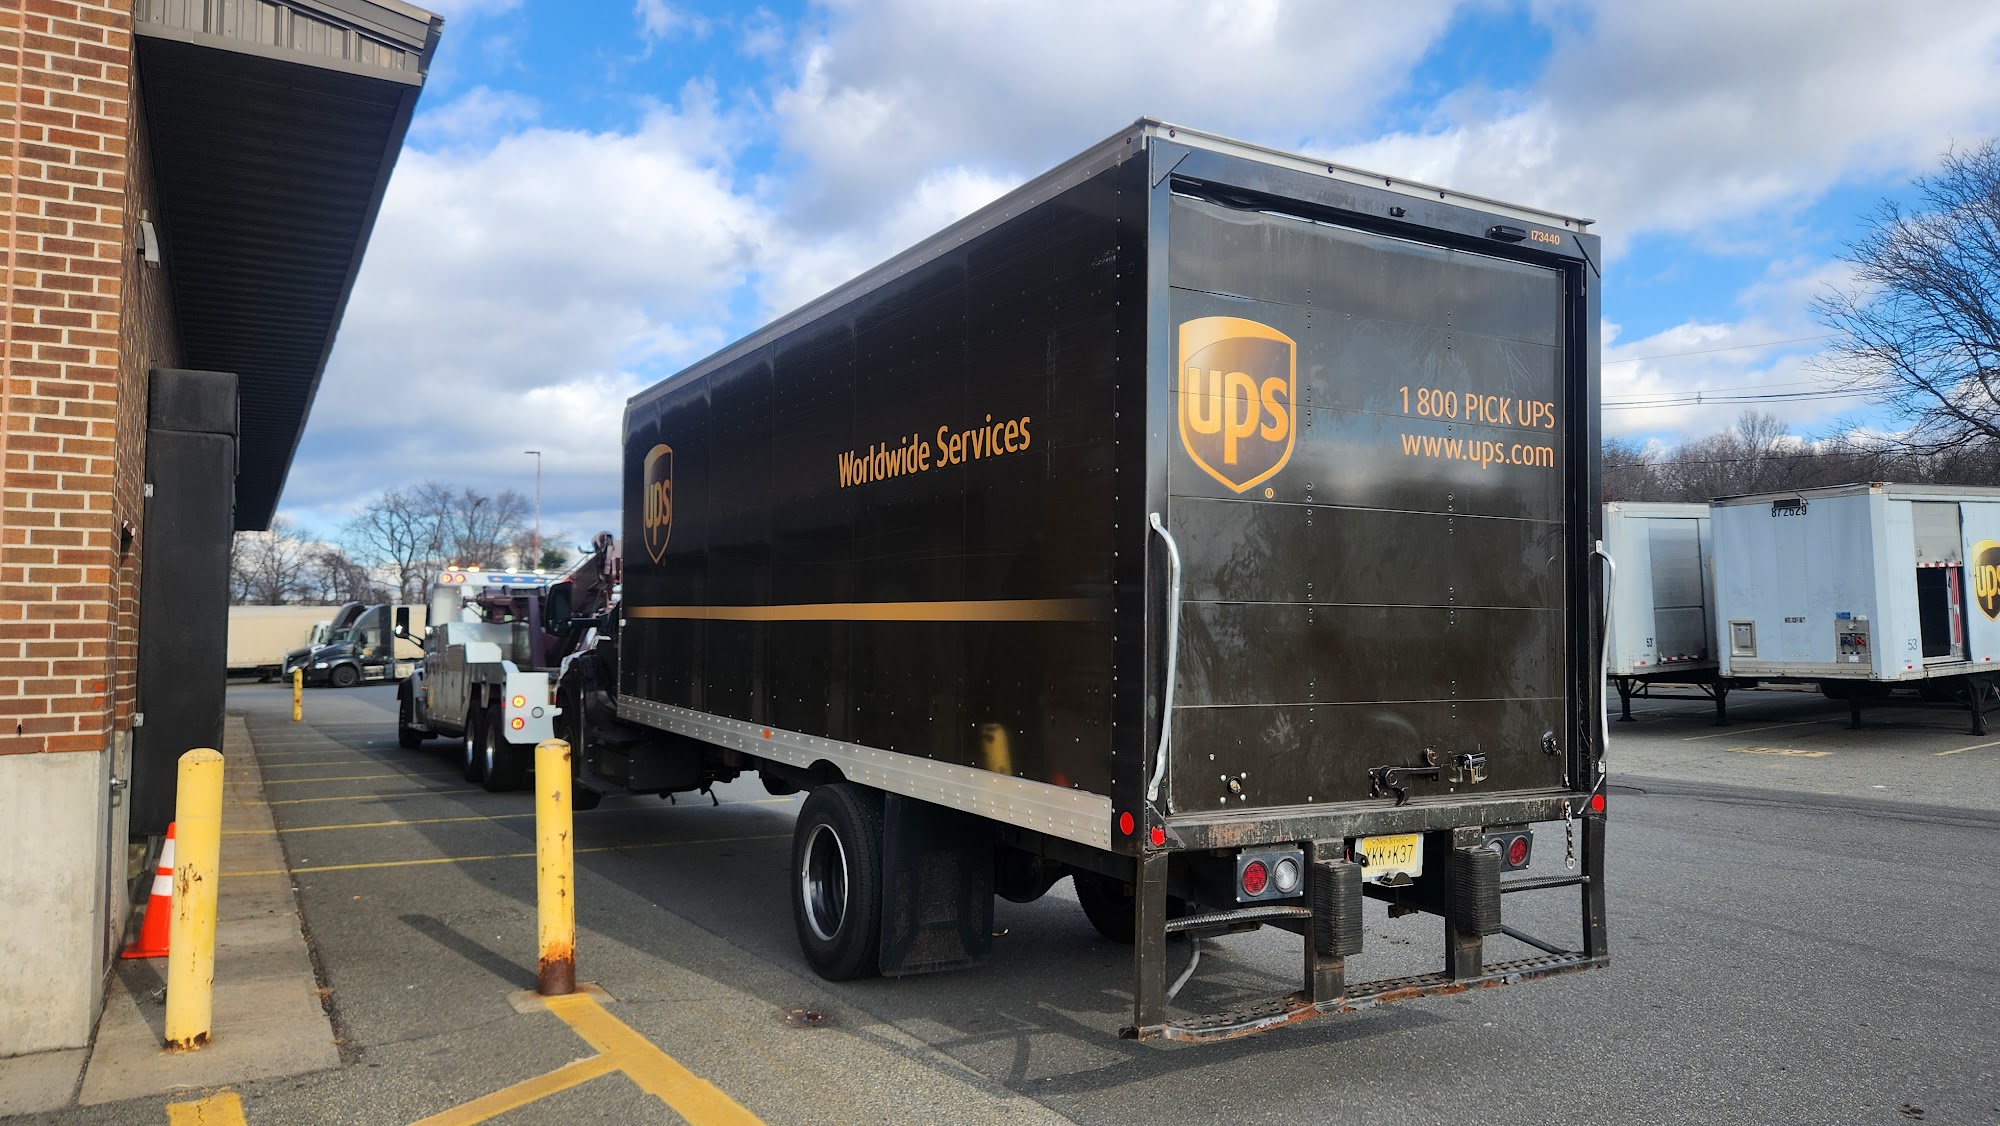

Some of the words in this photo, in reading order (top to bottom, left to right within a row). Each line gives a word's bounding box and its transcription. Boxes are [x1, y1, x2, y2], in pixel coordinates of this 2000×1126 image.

[1187, 367, 1289, 465] ups
[1400, 386, 1409, 414] 1
[1417, 387, 1458, 419] 800
[1465, 393, 1512, 425] PICK
[1518, 399, 1555, 429] UPS
[838, 433, 930, 488] Worldwide
[936, 413, 1031, 468] Services
[1401, 433, 1555, 470] www.ups.com
[645, 479, 671, 545] ups
[1393, 844, 1413, 865] K37
